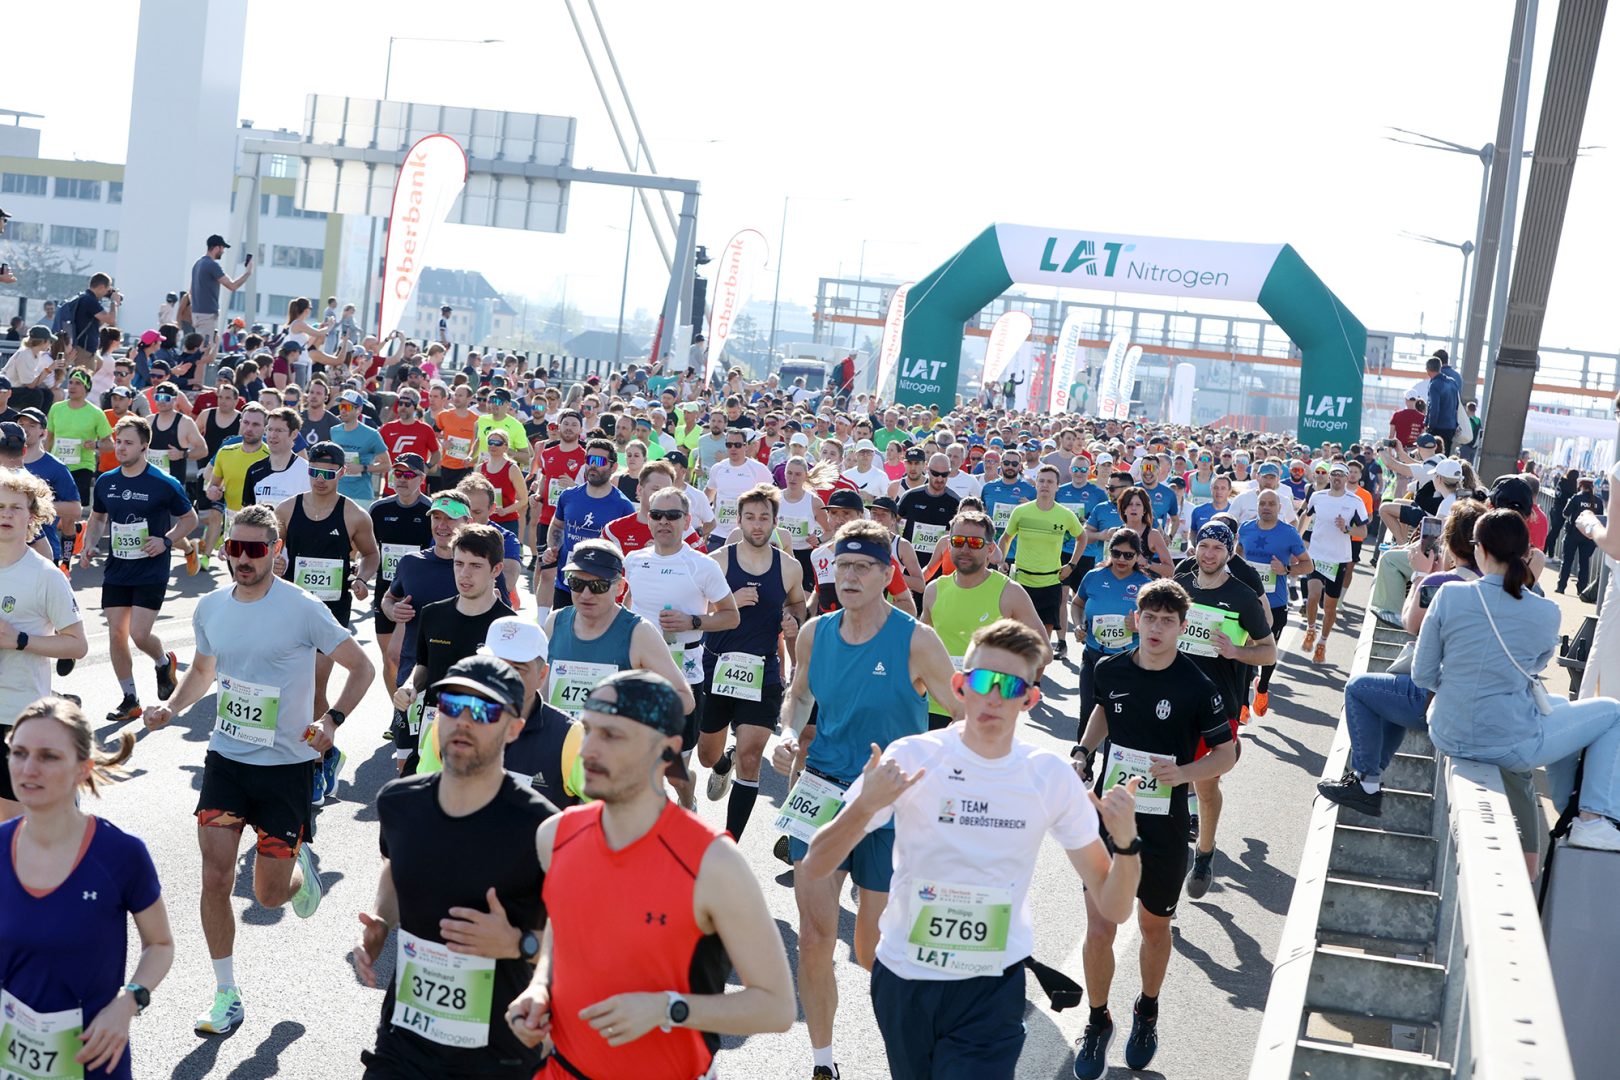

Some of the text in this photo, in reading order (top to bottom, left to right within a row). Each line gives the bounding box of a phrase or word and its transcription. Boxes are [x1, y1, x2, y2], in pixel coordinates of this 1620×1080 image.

[395, 150, 428, 301] Oberbank
[1039, 237, 1229, 289] LAT Nitrogen
[717, 239, 745, 340] Oberbank
[901, 357, 945, 381] LAT
[899, 379, 941, 394] Nitrogen
[1305, 394, 1350, 418] LAT
[1303, 418, 1348, 432] Nitrogen
[118, 537, 141, 546] 3336
[920, 533, 938, 543] 3095
[303, 573, 331, 586] 5921
[1100, 628, 1124, 638] 4765
[724, 668, 754, 683] 4420
[561, 686, 591, 703] 473
[716, 684, 735, 695] LAT
[226, 701, 263, 722] 4312
[1114, 703, 1123, 713] 15
[220, 719, 238, 736] LAT
[789, 794, 821, 818] 4064
[961, 800, 989, 814] TEAM
[959, 815, 1026, 830] OBERÖSTERREICH
[929, 916, 988, 942] 5769
[917, 947, 993, 974] LAT Nitrogen
[412, 975, 467, 1010] 3728
[403, 1006, 476, 1046] LAT Nitrogen
[8, 1038, 59, 1073] 4737
